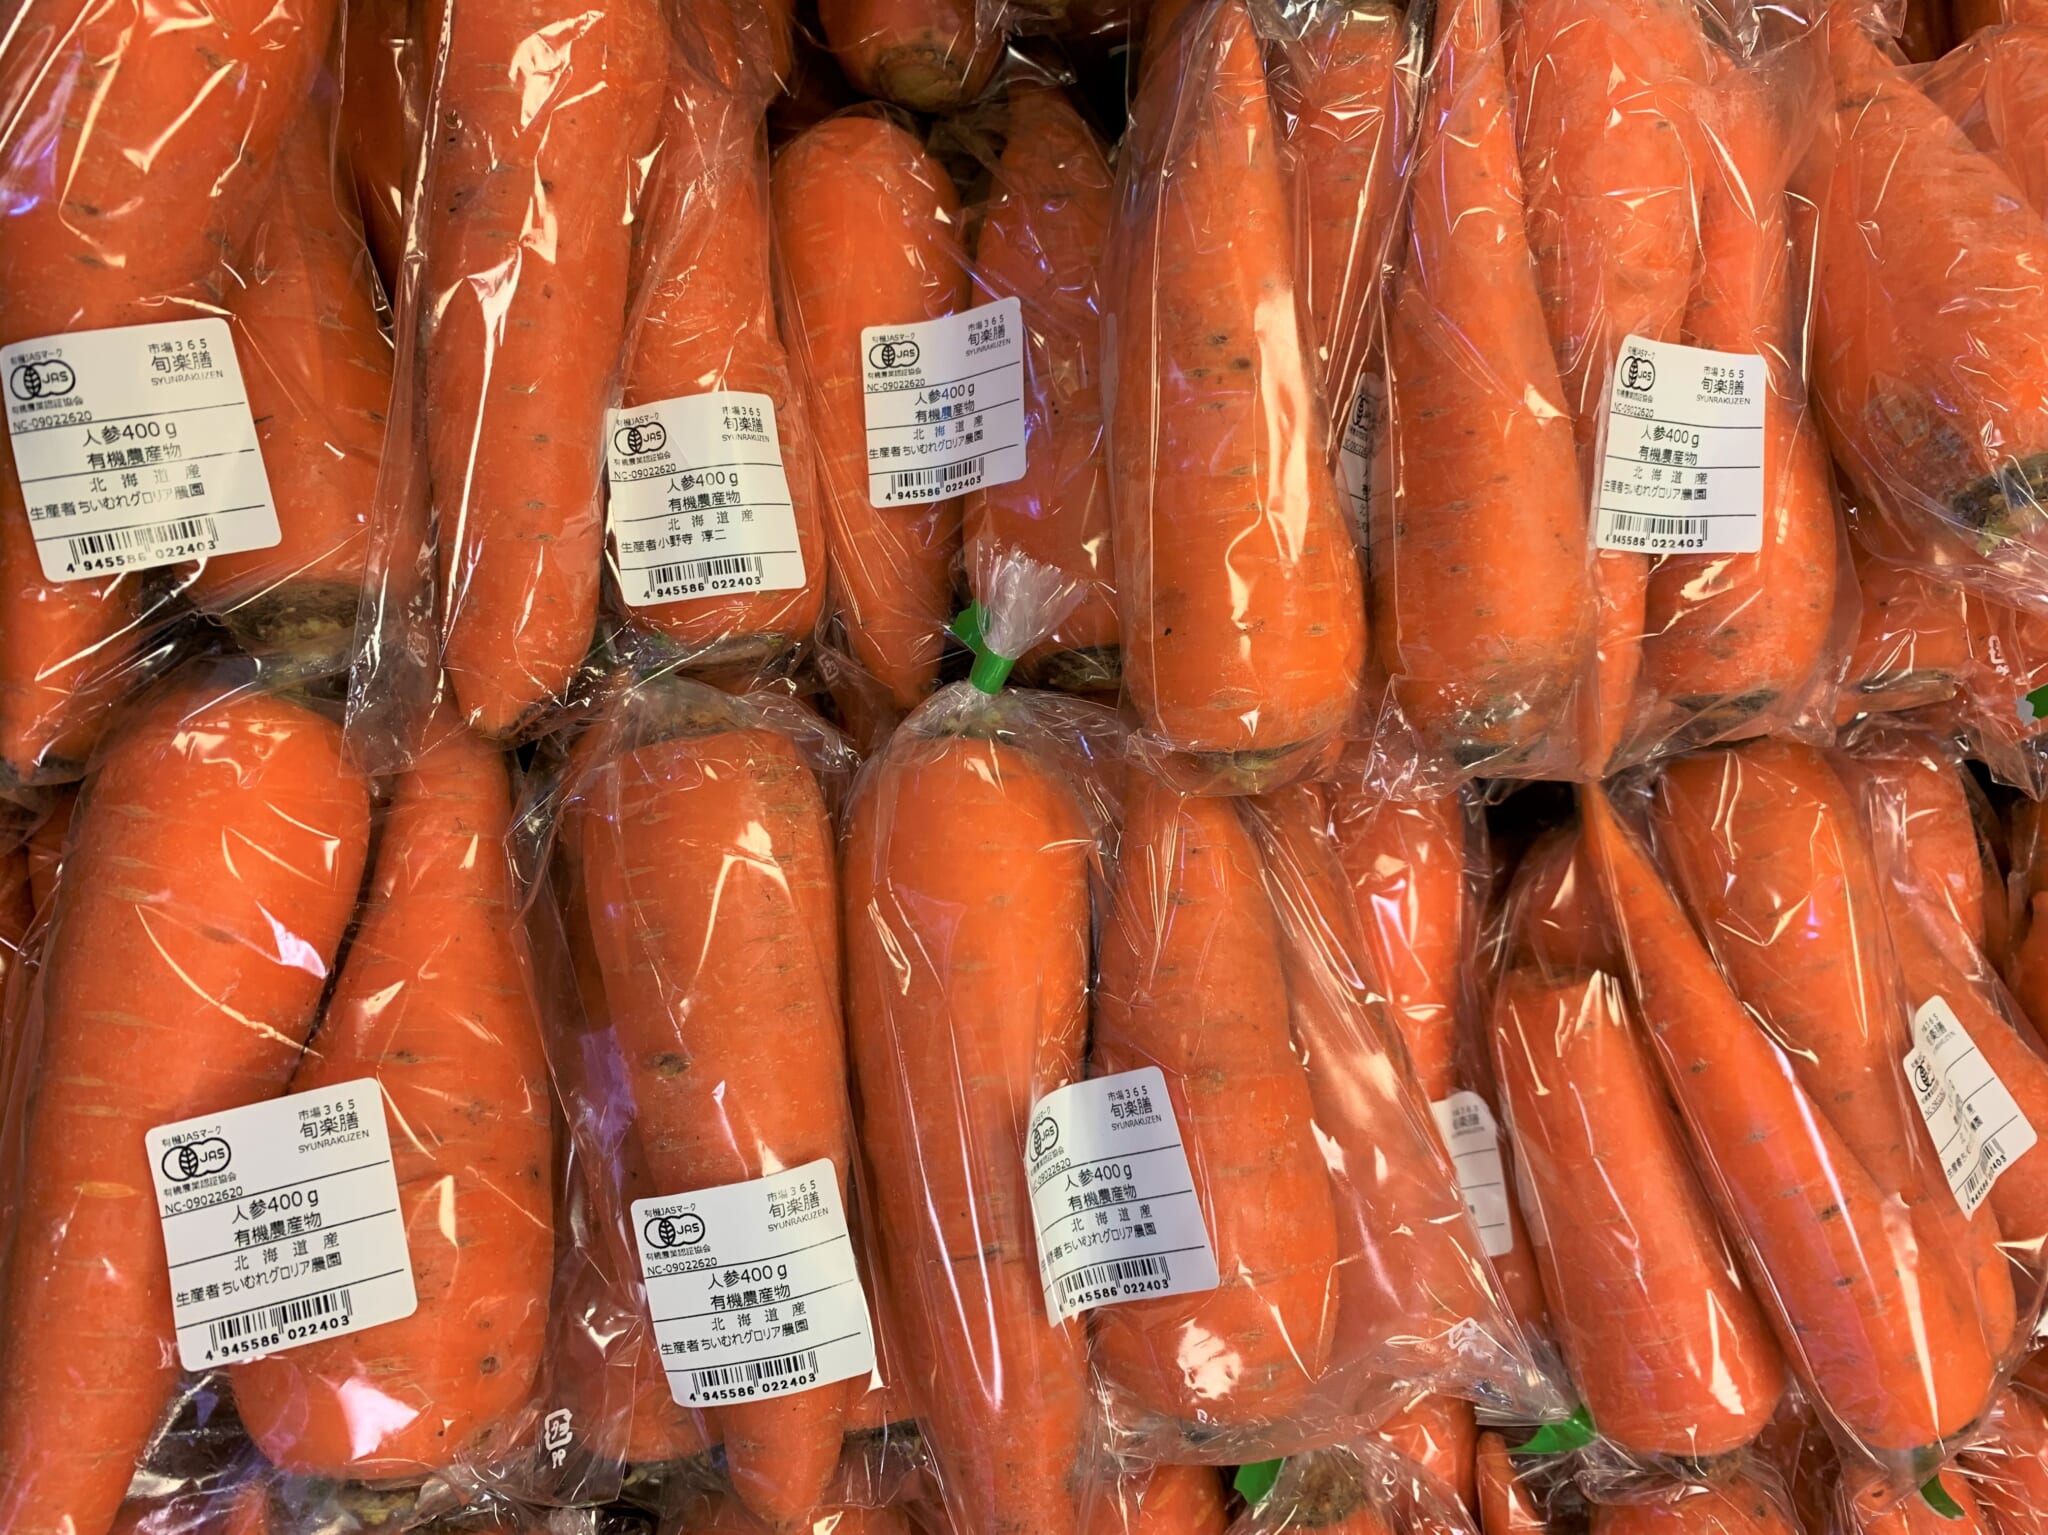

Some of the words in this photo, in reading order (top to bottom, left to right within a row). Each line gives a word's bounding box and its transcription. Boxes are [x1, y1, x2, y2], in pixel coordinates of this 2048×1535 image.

[968, 325, 1005, 346] 旬楽膳
[897, 348, 915, 358] JAS
[965, 339, 1011, 357] SYUNRAKUZEN
[151, 351, 212, 373] 旬楽膳
[43, 370, 68, 384] JAS
[151, 370, 223, 386] SYUNRAKUZEN
[867, 379, 925, 392] NC-09022620
[1638, 370, 1652, 381] JAS
[1701, 377, 1744, 396] 旬楽膳
[1696, 394, 1750, 405] SYUNRAKUZEN
[13, 411, 92, 431] NC-09022620
[915, 400, 975, 423] 有機農産物
[723, 418, 764, 433] 旬楽膳
[644, 433, 661, 443] JAS
[87, 444, 182, 469] 有機農産物
[1639, 445, 1697, 466] 有機農産物
[614, 464, 676, 480] NC-09022620
[898, 487, 940, 499] 945586
[946, 476, 981, 492] 022403
[668, 490, 740, 512] 有機農産物
[156, 541, 216, 559] 022403
[1651, 538, 1704, 548] 022403
[657, 583, 704, 597] 945586
[712, 577, 761, 590] 022403
[1111, 1097, 1153, 1119] 旬楽膳
[299, 1112, 359, 1140] 旬楽膳
[1111, 1114, 1162, 1131] SYUNRAKUZEN
[298, 1130, 369, 1153] SYUNRAKUZEN
[1041, 1125, 1055, 1141] JAS
[200, 1148, 225, 1163] JAS
[165, 1186, 243, 1214] NC-09022620
[769, 1191, 820, 1219] 旬楽膳
[1068, 1184, 1137, 1211] 有機農産物
[234, 1211, 322, 1247] 有機農産物
[676, 1223, 700, 1235] JAS
[768, 1208, 829, 1232] SYUNRAKUZEN
[647, 1257, 717, 1275] NC-09022620
[710, 1283, 791, 1311] 有機農産物
[1070, 1287, 1118, 1308] 945586
[1123, 1279, 1169, 1295] 022403
[221, 1334, 279, 1357] 945586
[288, 1315, 350, 1340] 022403
[703, 1385, 754, 1401] 945586
[763, 1373, 815, 1393] 022403
